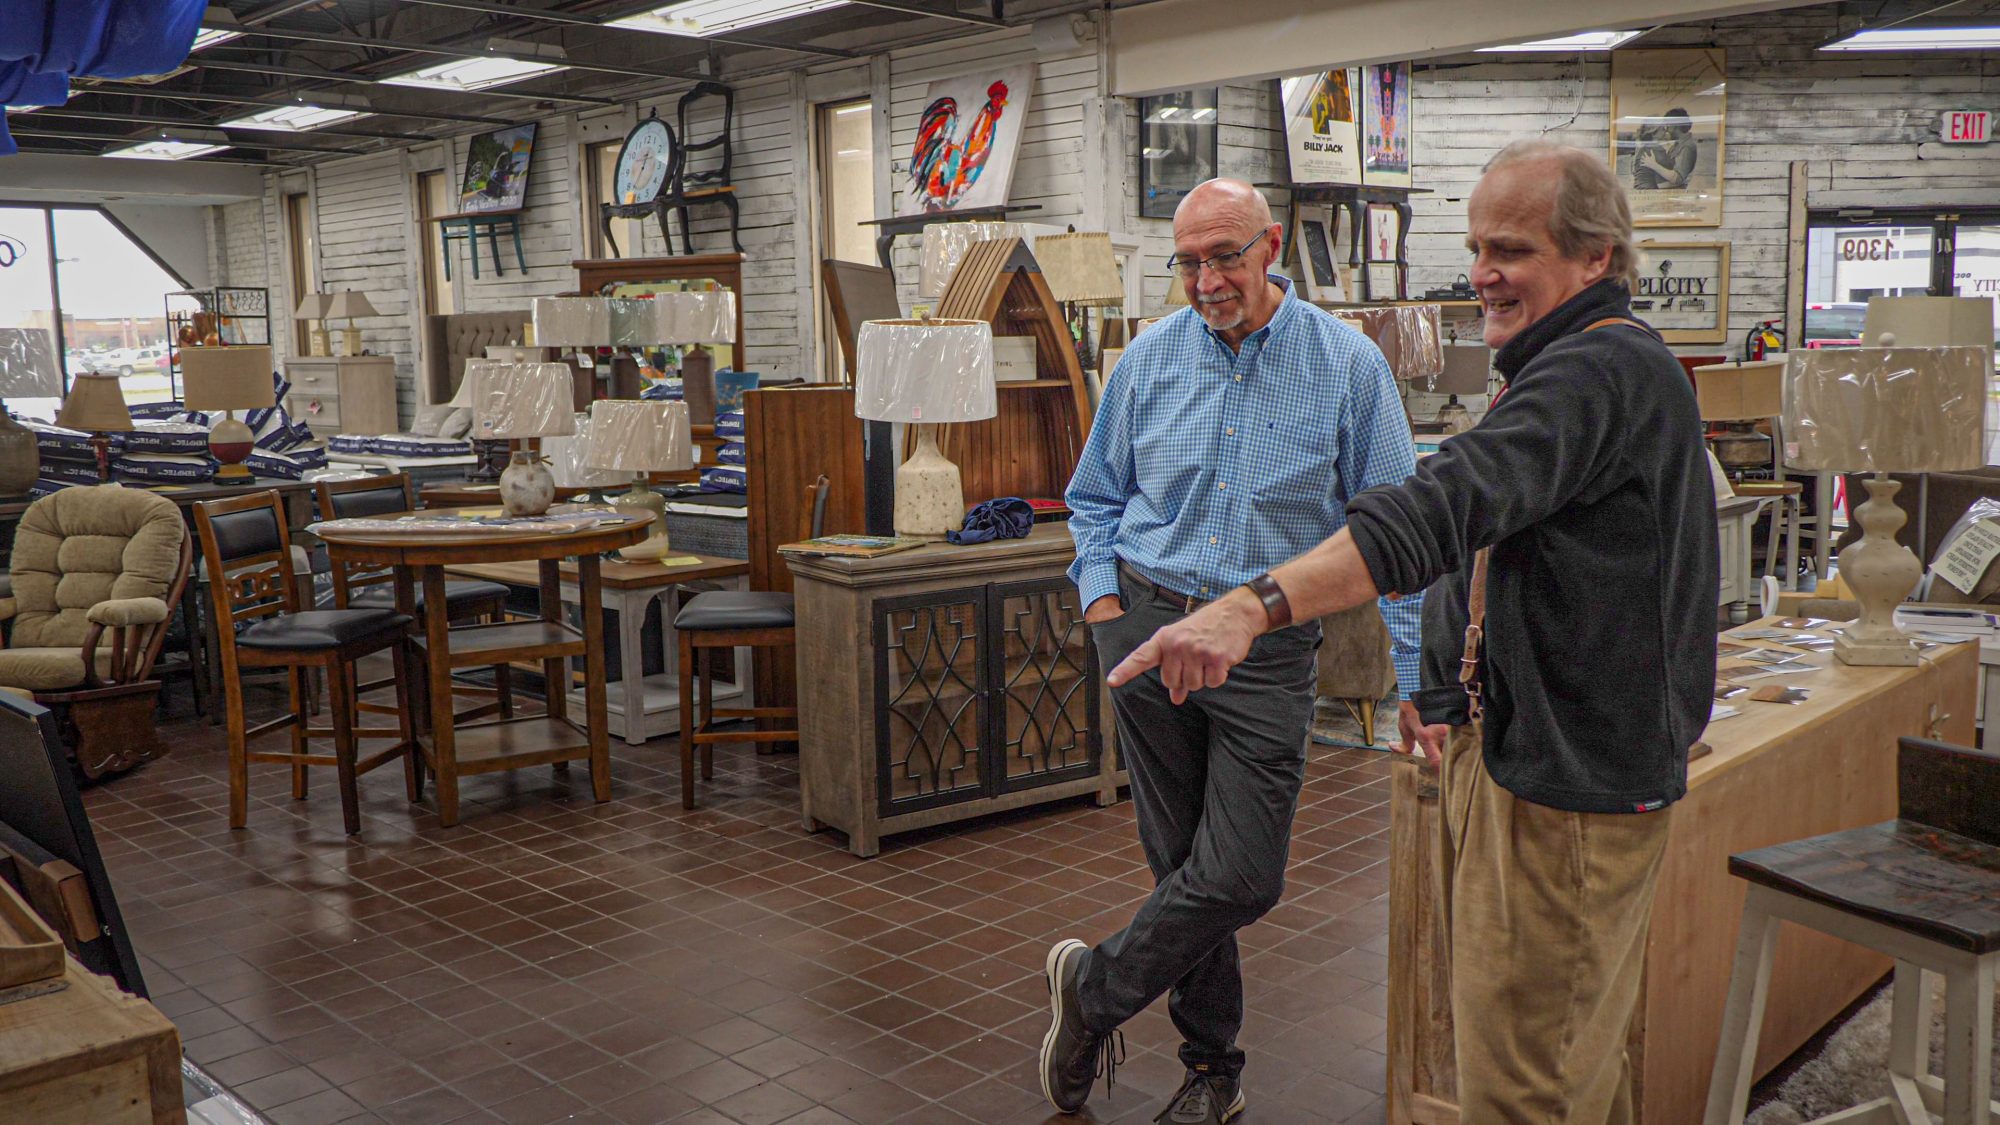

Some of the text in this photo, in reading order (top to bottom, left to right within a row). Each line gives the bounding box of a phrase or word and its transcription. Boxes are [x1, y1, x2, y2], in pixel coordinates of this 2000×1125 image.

[1951, 112, 1986, 140] EXIT
[1303, 142, 1343, 153] BILLY JACK
[1638, 277, 1708, 295] PLICITY
